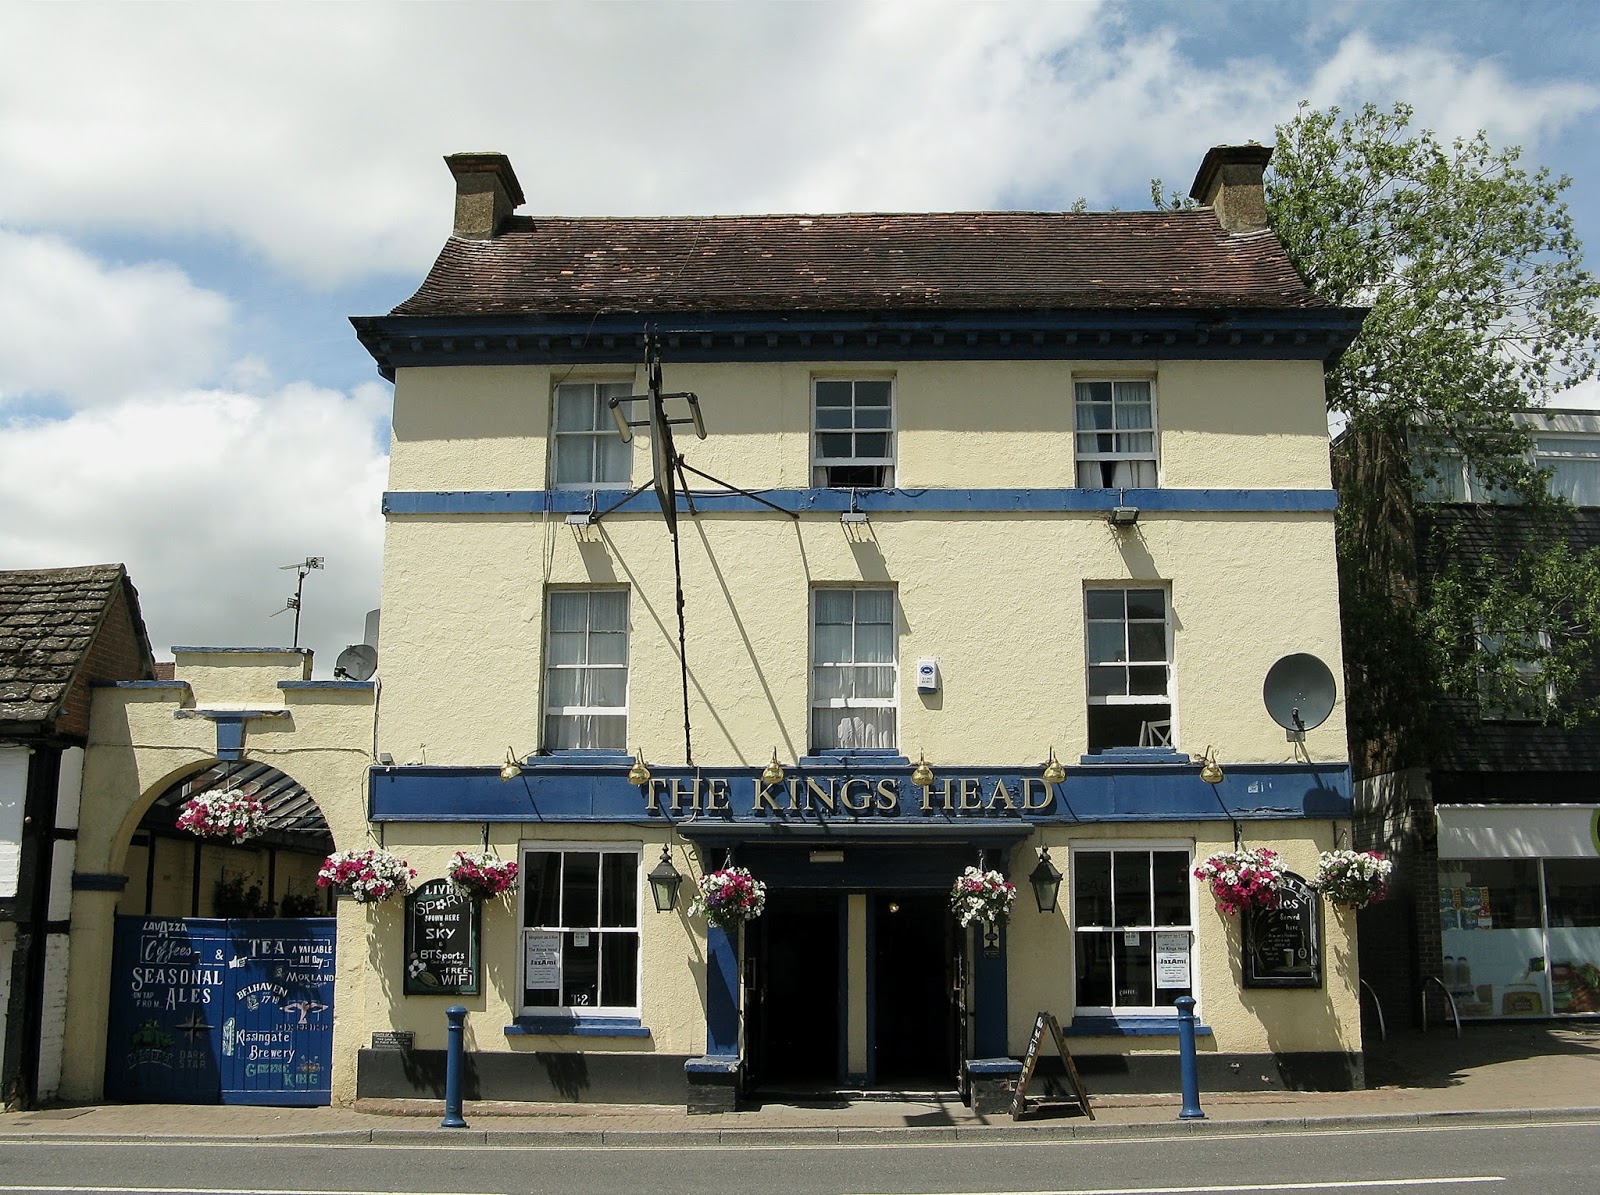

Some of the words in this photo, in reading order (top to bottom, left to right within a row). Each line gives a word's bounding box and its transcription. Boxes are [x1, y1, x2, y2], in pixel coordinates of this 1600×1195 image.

[644, 778, 730, 810] THE
[751, 777, 897, 810] KINGS
[919, 777, 1054, 810] HEAD
[142, 921, 188, 938] LAVAZZA
[425, 928, 456, 940] SKY
[145, 940, 192, 964] Coffees
[214, 948, 224, 961] &
[248, 939, 285, 958] TEA
[291, 945, 333, 954] AVAILABLE
[286, 972, 334, 983] MORLAND
[445, 967, 469, 975] FREE
[131, 967, 223, 992] SEASONAL
[441, 974, 473, 986] WIFI
[236, 982, 288, 1000] BELHAVEN
[165, 987, 211, 1011] ALES
[180, 1050, 206, 1060] DARK
[249, 1045, 295, 1064] Brewery
[180, 1060, 206, 1069] STAR
[283, 1073, 319, 1088] KING
